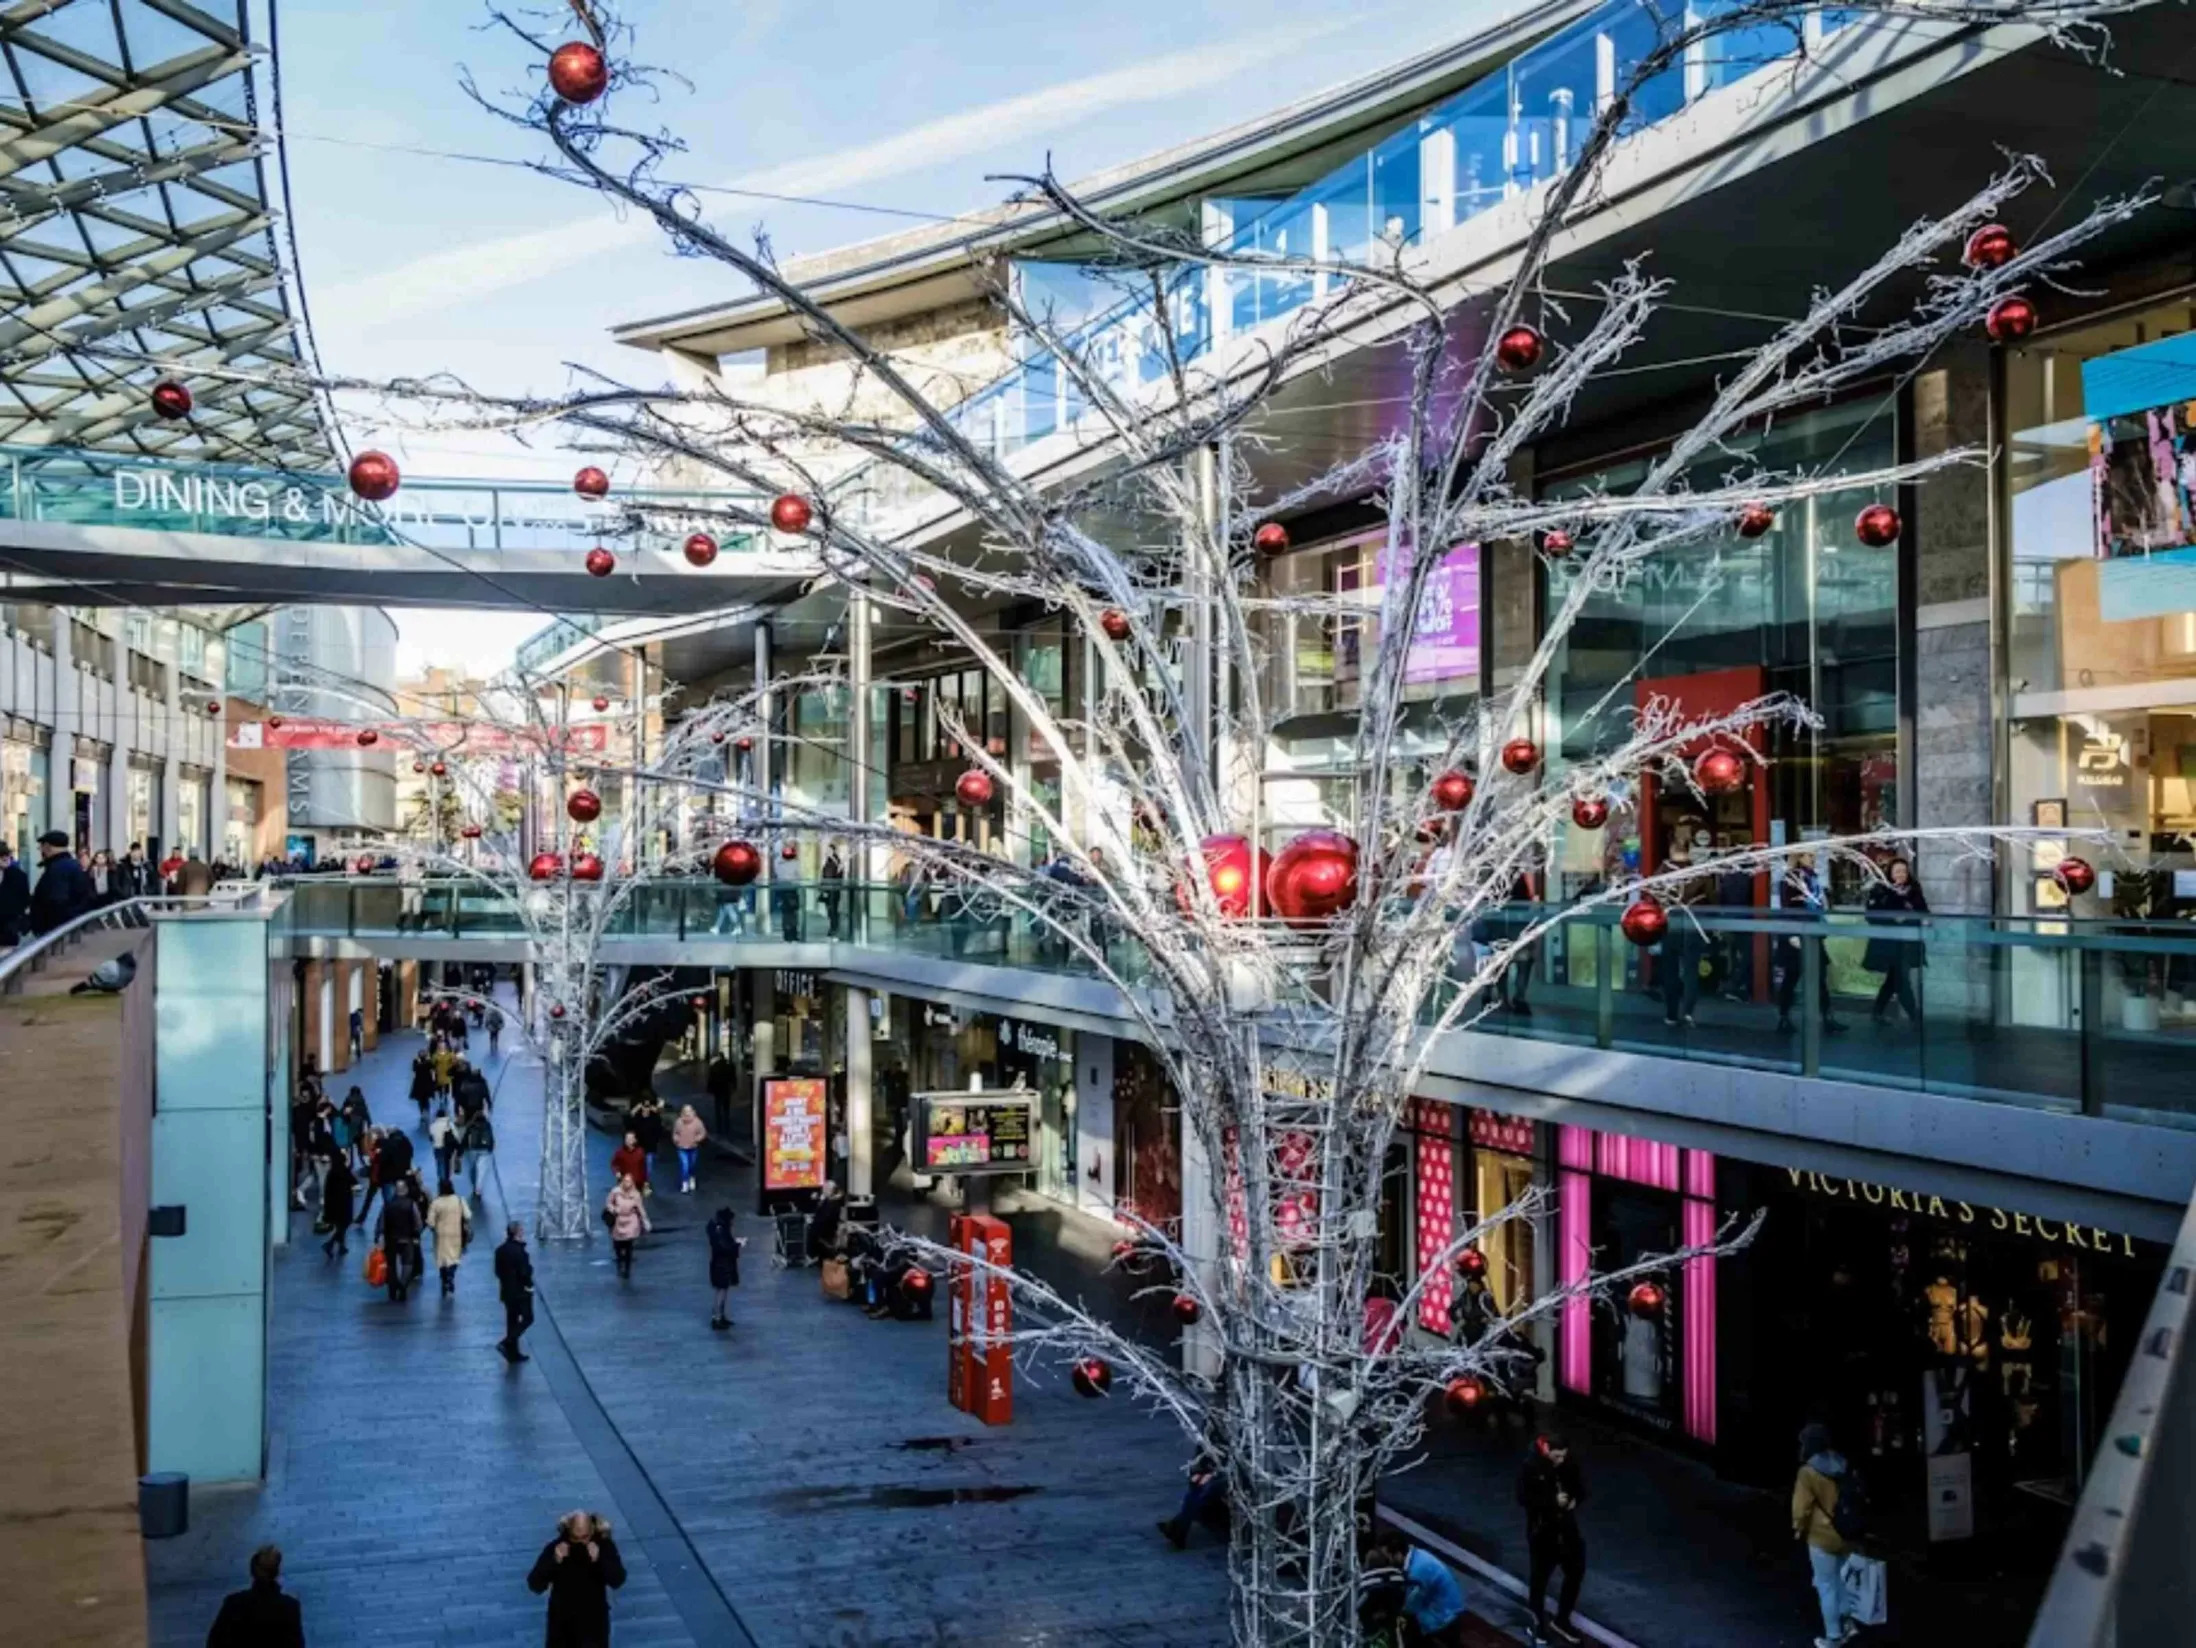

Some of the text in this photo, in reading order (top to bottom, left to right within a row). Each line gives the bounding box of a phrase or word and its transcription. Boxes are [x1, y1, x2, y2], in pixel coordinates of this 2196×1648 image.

[114, 470, 269, 519] DINING
[284, 486, 310, 521] &
[774, 969, 815, 999] OFFICE
[1787, 1165, 2137, 1258] VICTORIAS SECRET
